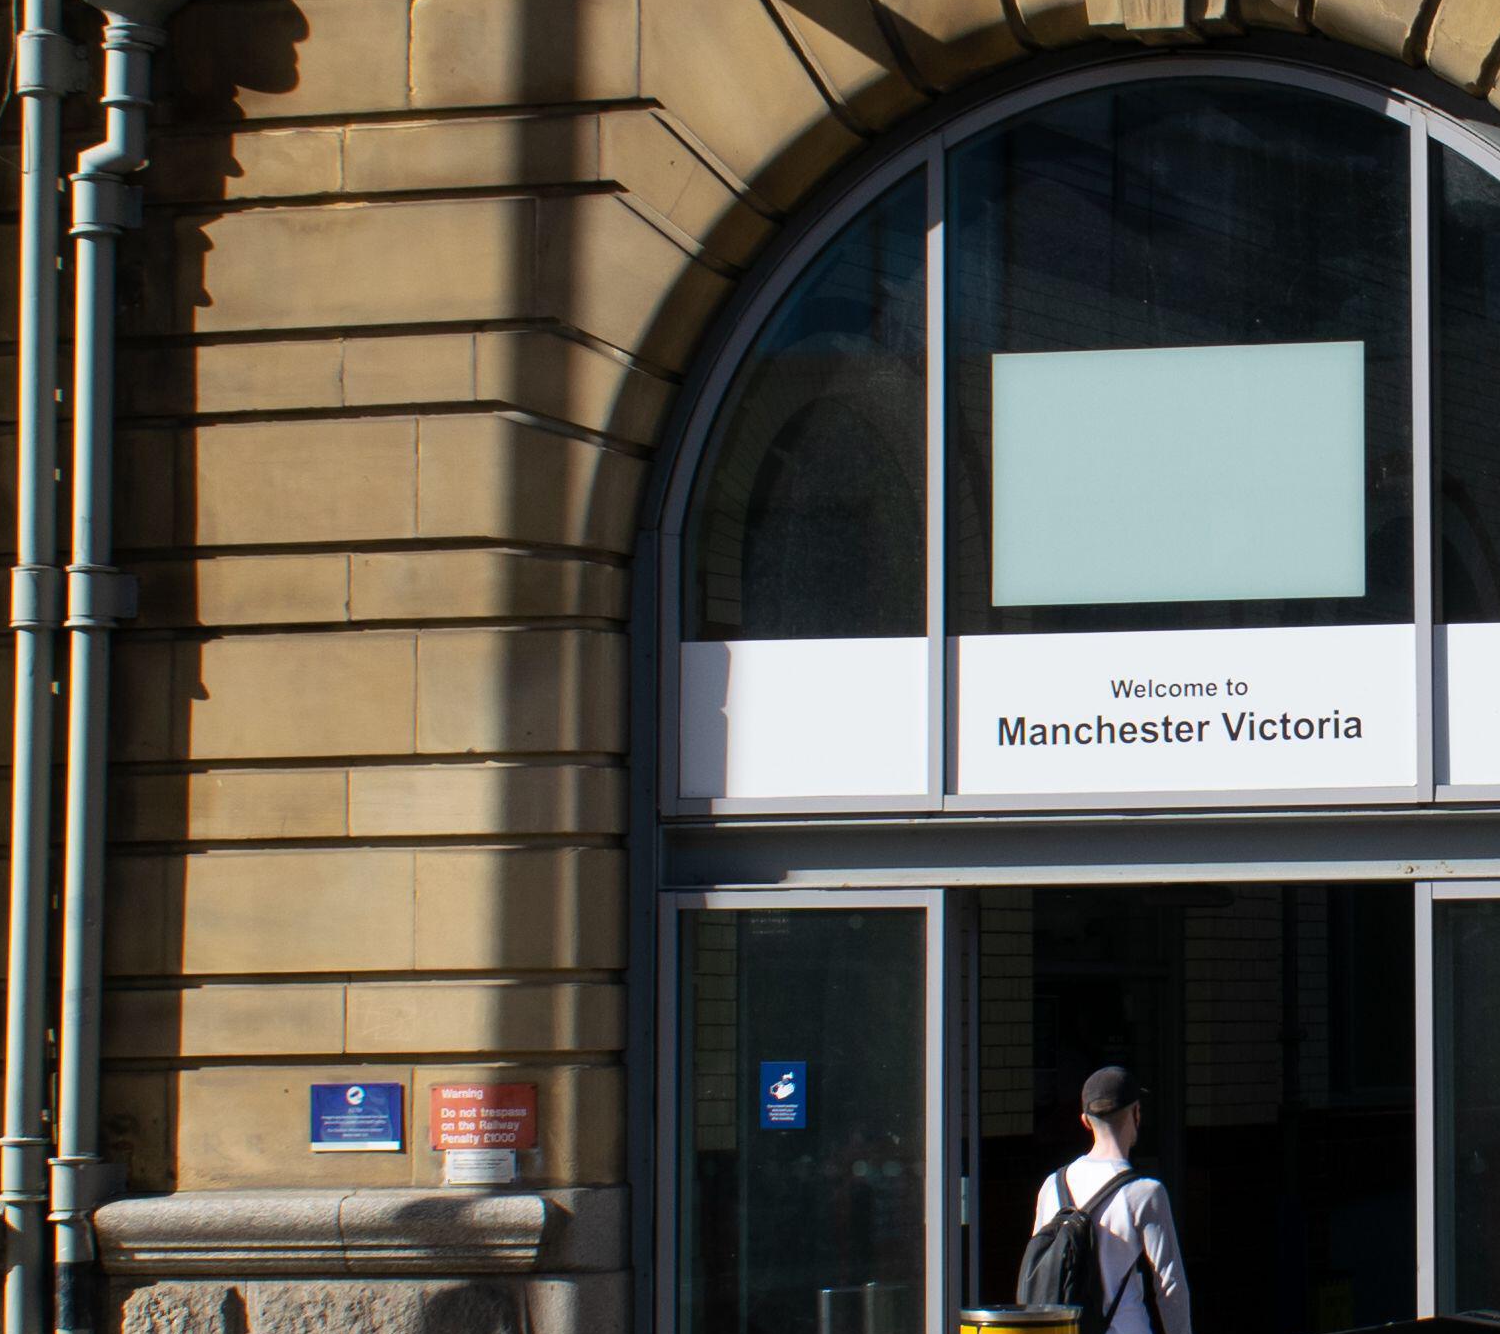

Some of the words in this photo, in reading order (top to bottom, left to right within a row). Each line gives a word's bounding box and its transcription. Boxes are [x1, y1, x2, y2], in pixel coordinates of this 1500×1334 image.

[1111, 679, 1218, 698] Welcome
[1227, 678, 1249, 696] to
[998, 715, 1210, 746] Manchester
[1222, 709, 1363, 741] Victoria
[441, 1088, 484, 1100] Warning
[441, 1108, 456, 1118] Do
[459, 1108, 477, 1118] not
[480, 1108, 527, 1118] trespass
[441, 1120, 455, 1131] on
[458, 1120, 475, 1131] the
[479, 1120, 520, 1131] Railway
[441, 1133, 480, 1145] Penalty
[483, 1134, 516, 1144] £1000
